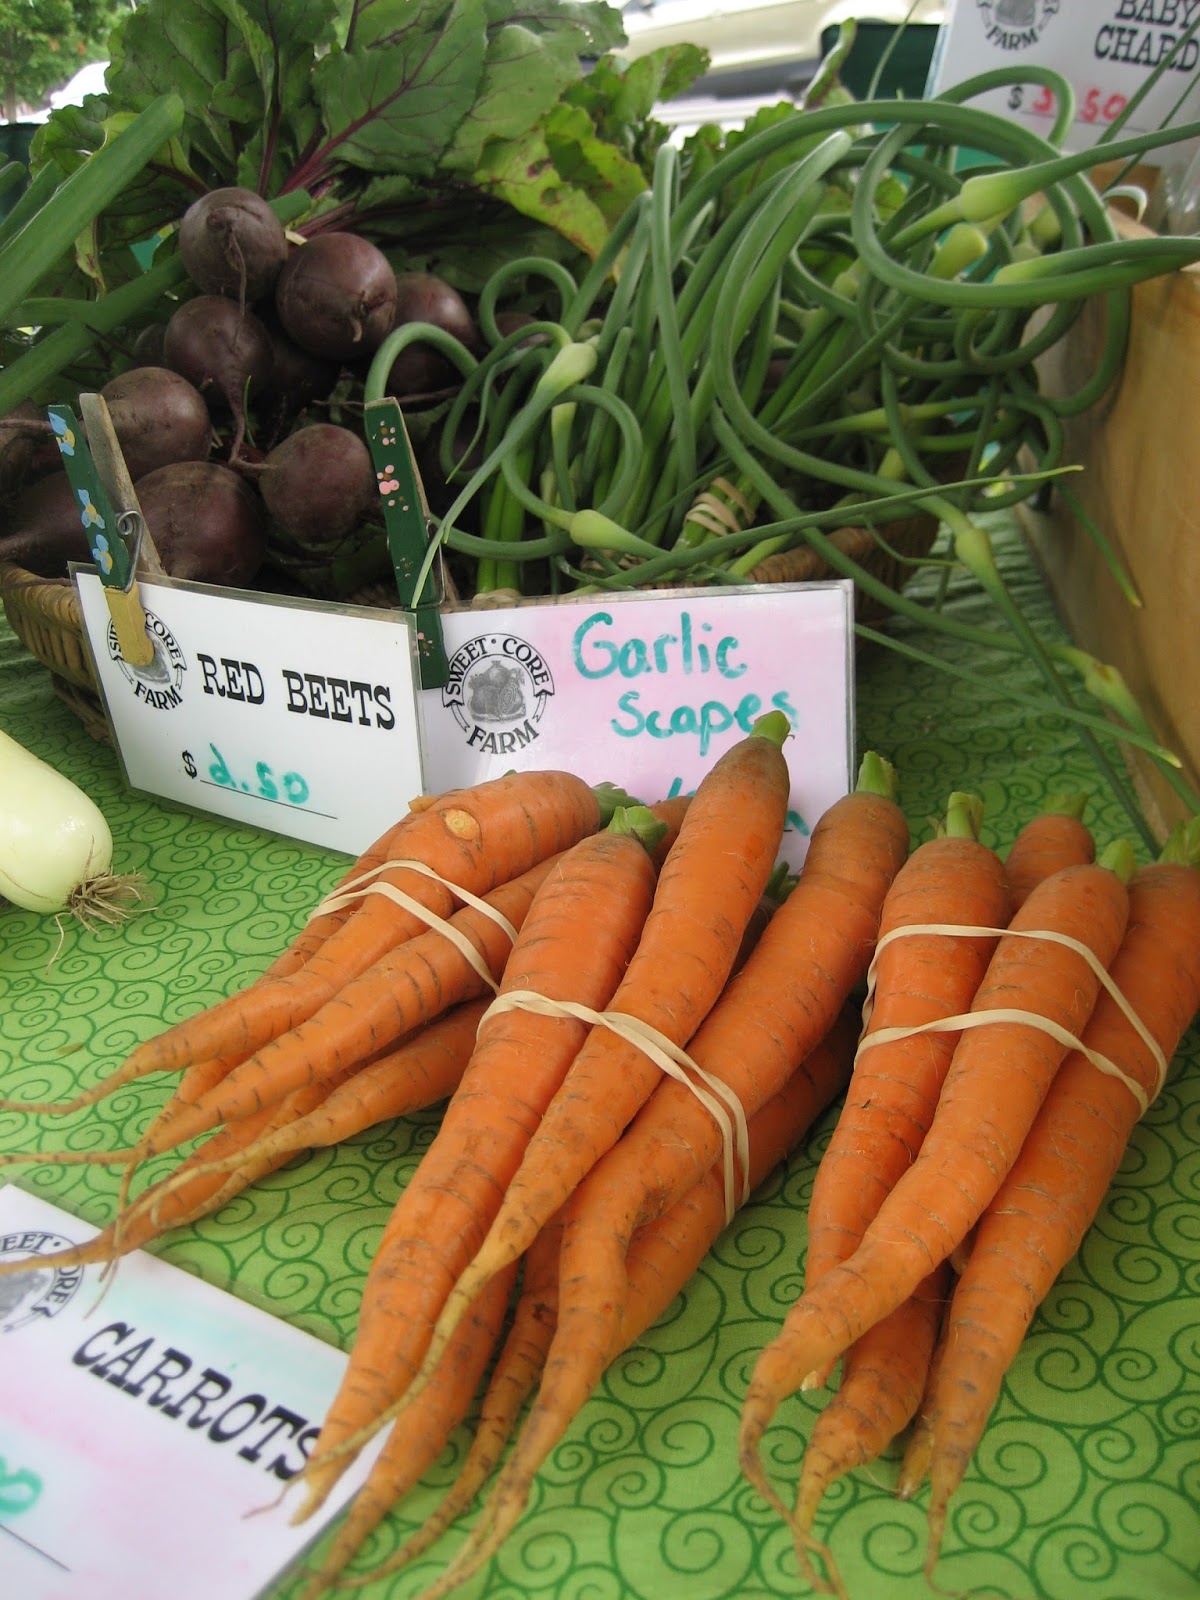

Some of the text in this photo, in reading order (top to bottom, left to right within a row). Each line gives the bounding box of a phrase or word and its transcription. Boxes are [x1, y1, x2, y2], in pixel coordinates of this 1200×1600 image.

[986, 25, 1039, 51] FARM
[1115, 0, 1200, 29] BABY
[145, 612, 181, 660] CORE
[572, 612, 748, 679] Garlic
[446, 637, 550, 696] SWEET CORE
[134, 681, 183, 710] FARM
[197, 653, 396, 731] RED BEETS
[466, 719, 540, 755] FARM
[611, 690, 799, 757] Scapes
[182, 750, 198, 779] $
[72, 1322, 323, 1481] CARROTS
